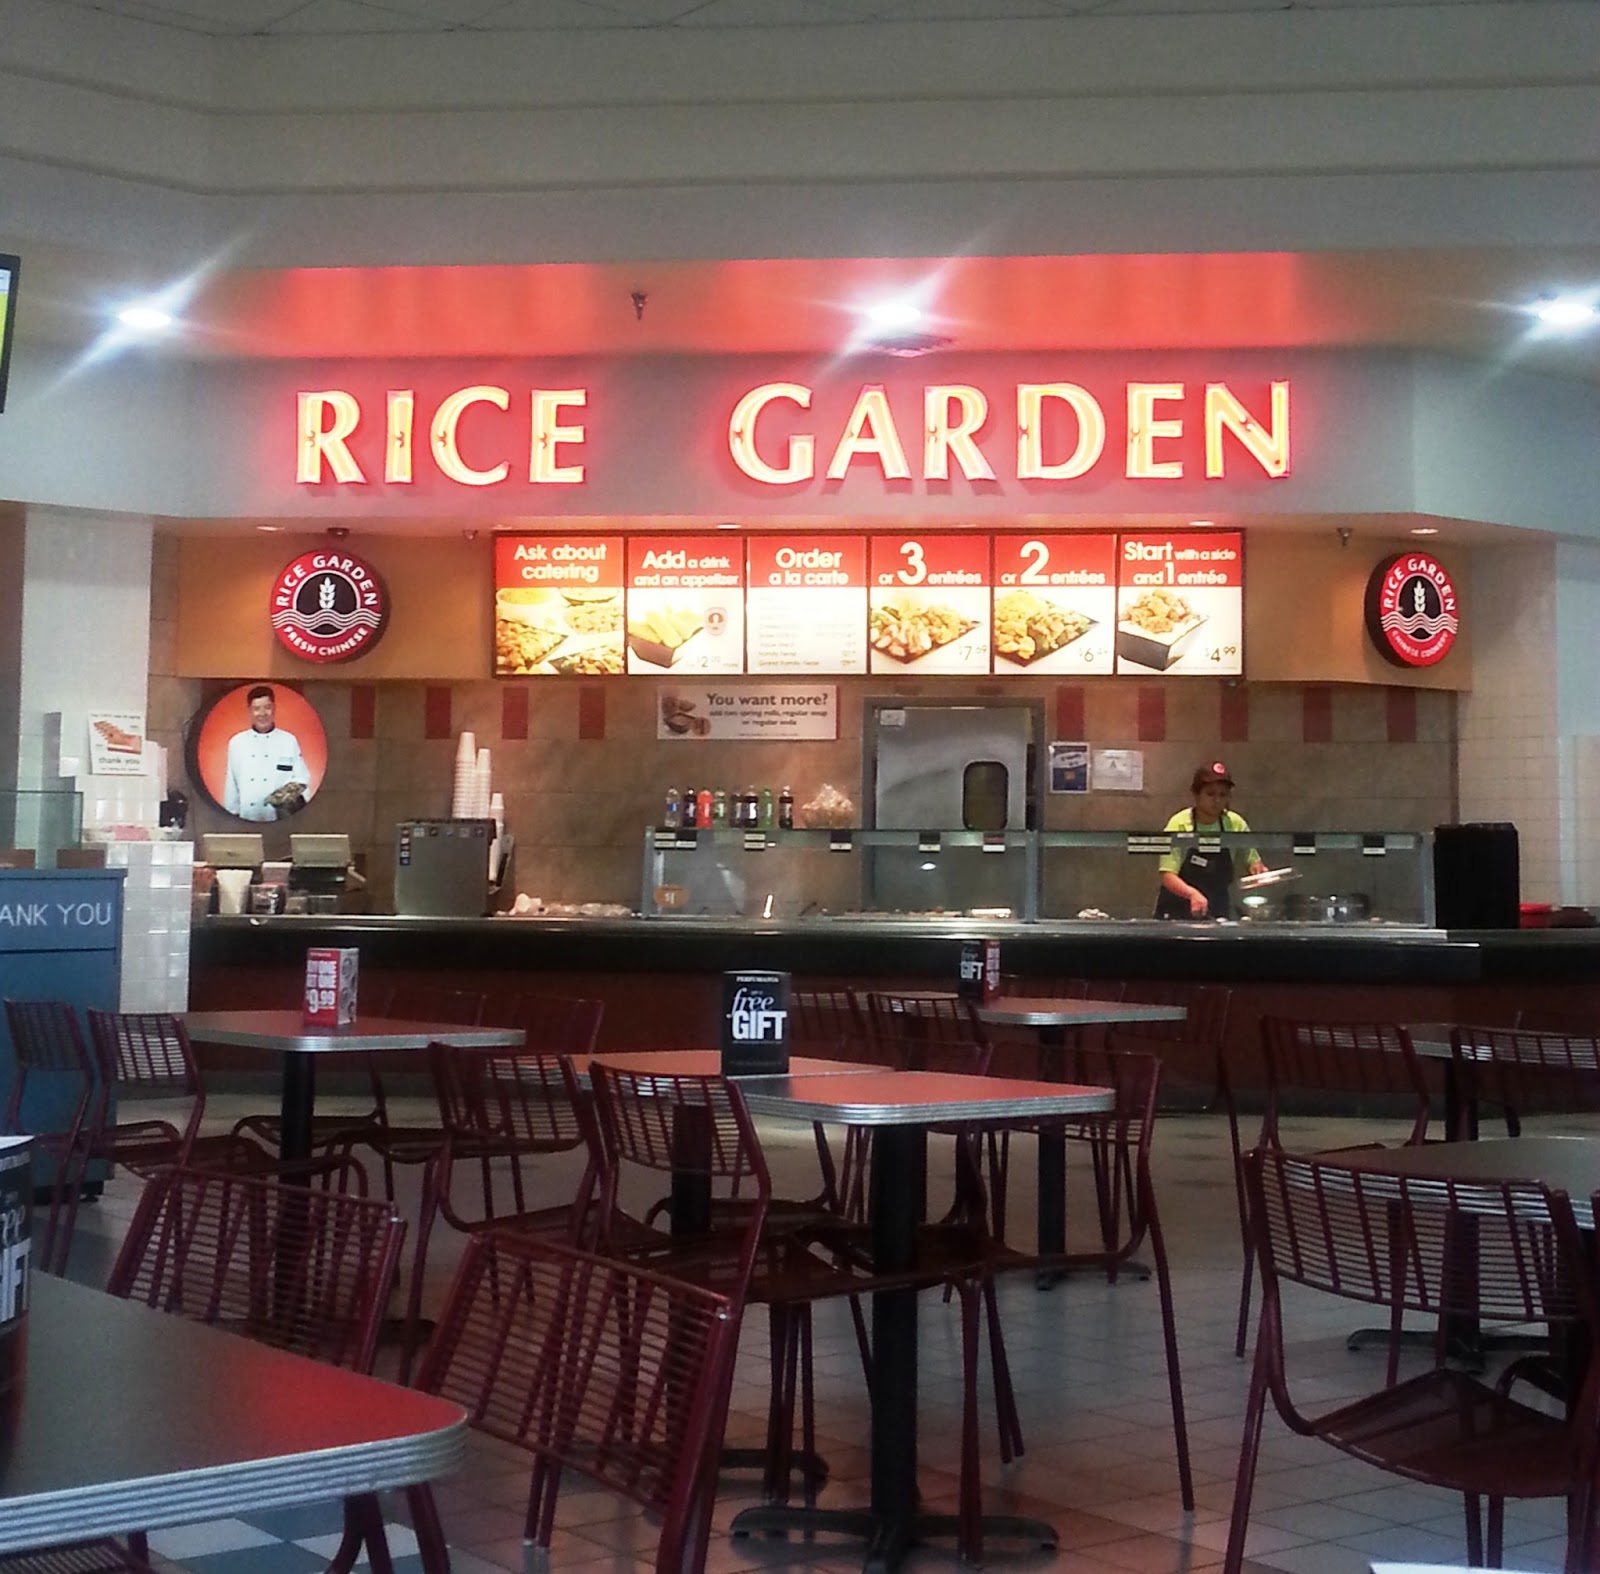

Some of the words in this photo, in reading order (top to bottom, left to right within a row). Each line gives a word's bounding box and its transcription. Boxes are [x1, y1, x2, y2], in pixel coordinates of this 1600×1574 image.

[296, 385, 588, 486] RICE
[728, 381, 1291, 484] GARDEN
[514, 544, 547, 561] Ask
[551, 543, 607, 561] about
[641, 549, 687, 570] Add
[687, 558, 699, 569] a
[699, 556, 731, 569] drink
[775, 547, 843, 569] Order
[878, 573, 895, 585] or
[897, 541, 927, 585] 3
[926, 569, 982, 585] entrées
[1000, 573, 1017, 585] or
[1020, 541, 1050, 585] 2
[1050, 569, 1106, 585] entrées
[1124, 541, 1173, 561] Start
[1210, 549, 1237, 561] side
[276, 564, 306, 607] RICE
[312, 555, 378, 606] GARDEN
[522, 562, 599, 584] catering
[633, 573, 660, 586] and
[661, 575, 680, 586] an
[680, 572, 739, 588] appetizer
[768, 572, 782, 585] a
[785, 570, 802, 585] la
[804, 570, 850, 585] carte
[1133, 570, 1164, 585] and
[1164, 561, 1175, 585] 1
[1177, 569, 1228, 585] entrée
[1383, 566, 1405, 610] RICE
[1407, 558, 1456, 611] GARDEN
[284, 626, 317, 654] FRESH
[318, 627, 369, 656] CHINESE
[707, 693, 734, 706] You
[739, 695, 776, 706] want
[780, 693, 828, 706] more?
[57, 902, 112, 926] YOU
[960, 961, 984, 980] GIFT
[726, 987, 775, 1019] free
[732, 1010, 788, 1040] GIFT
